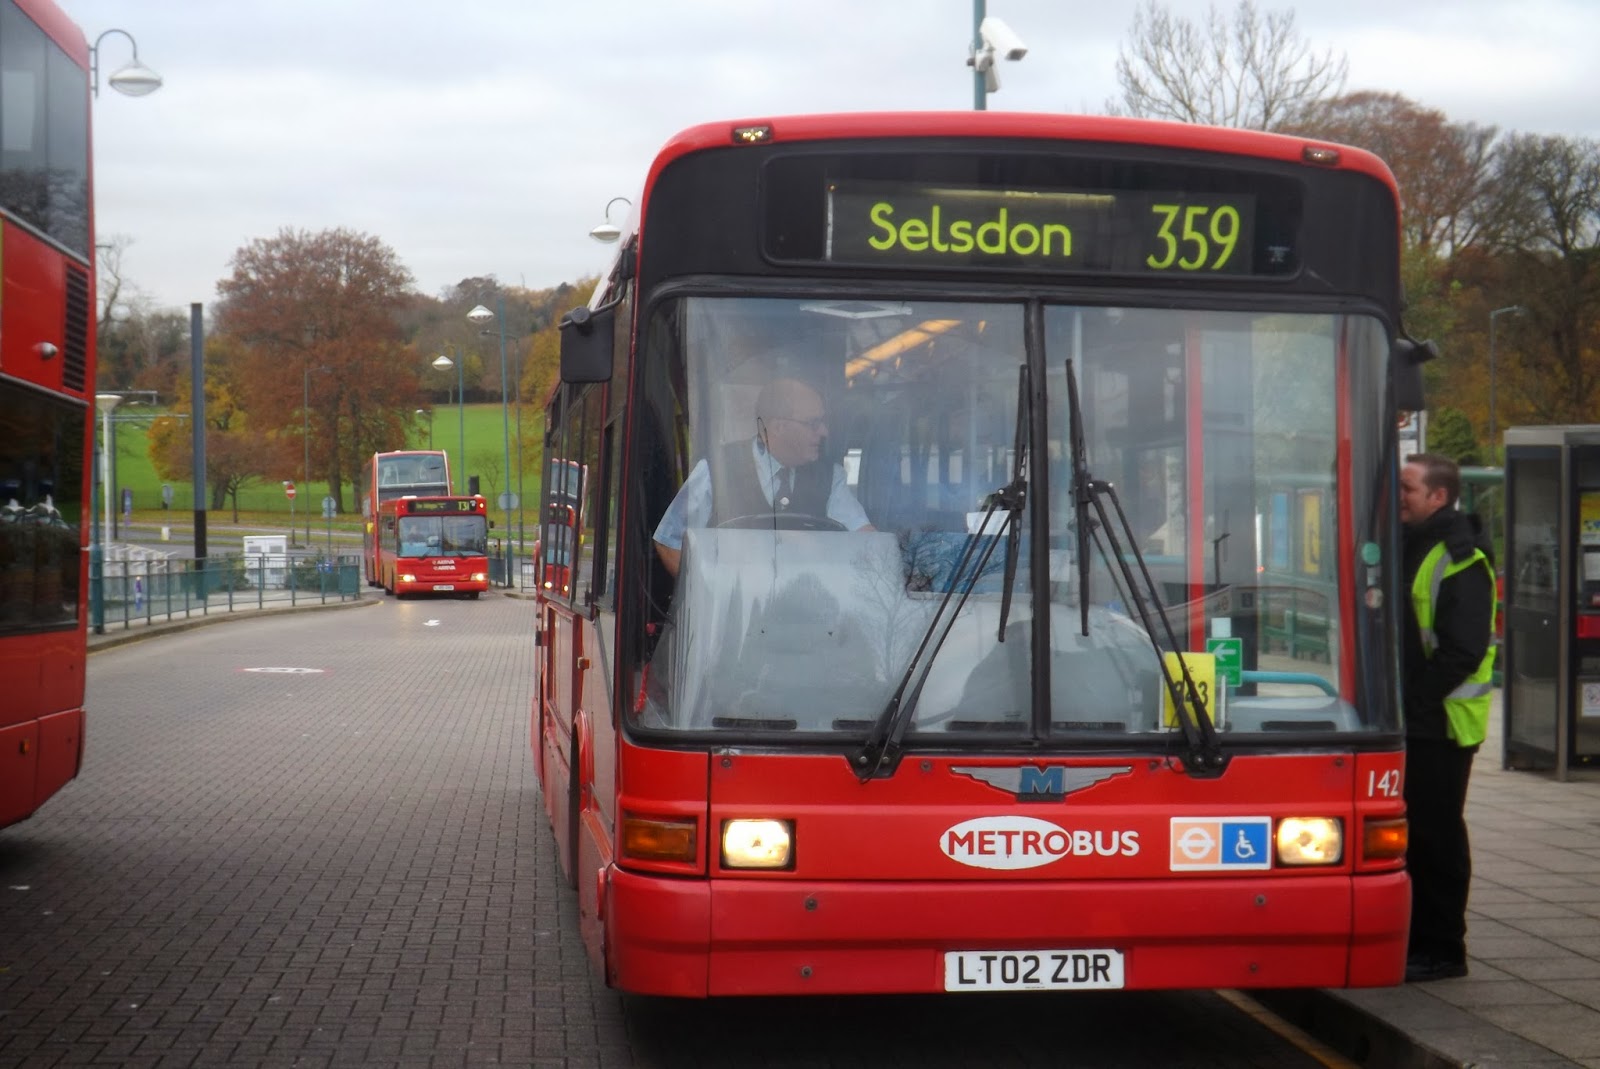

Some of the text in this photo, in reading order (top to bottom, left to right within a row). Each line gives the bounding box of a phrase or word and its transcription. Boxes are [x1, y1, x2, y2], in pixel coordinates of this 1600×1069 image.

[868, 203, 1241, 271] Selsdon 359
[1368, 769, 1400, 797] 142
[948, 830, 1140, 857] METROBUS
[958, 954, 1111, 984] LT02 ZDR
